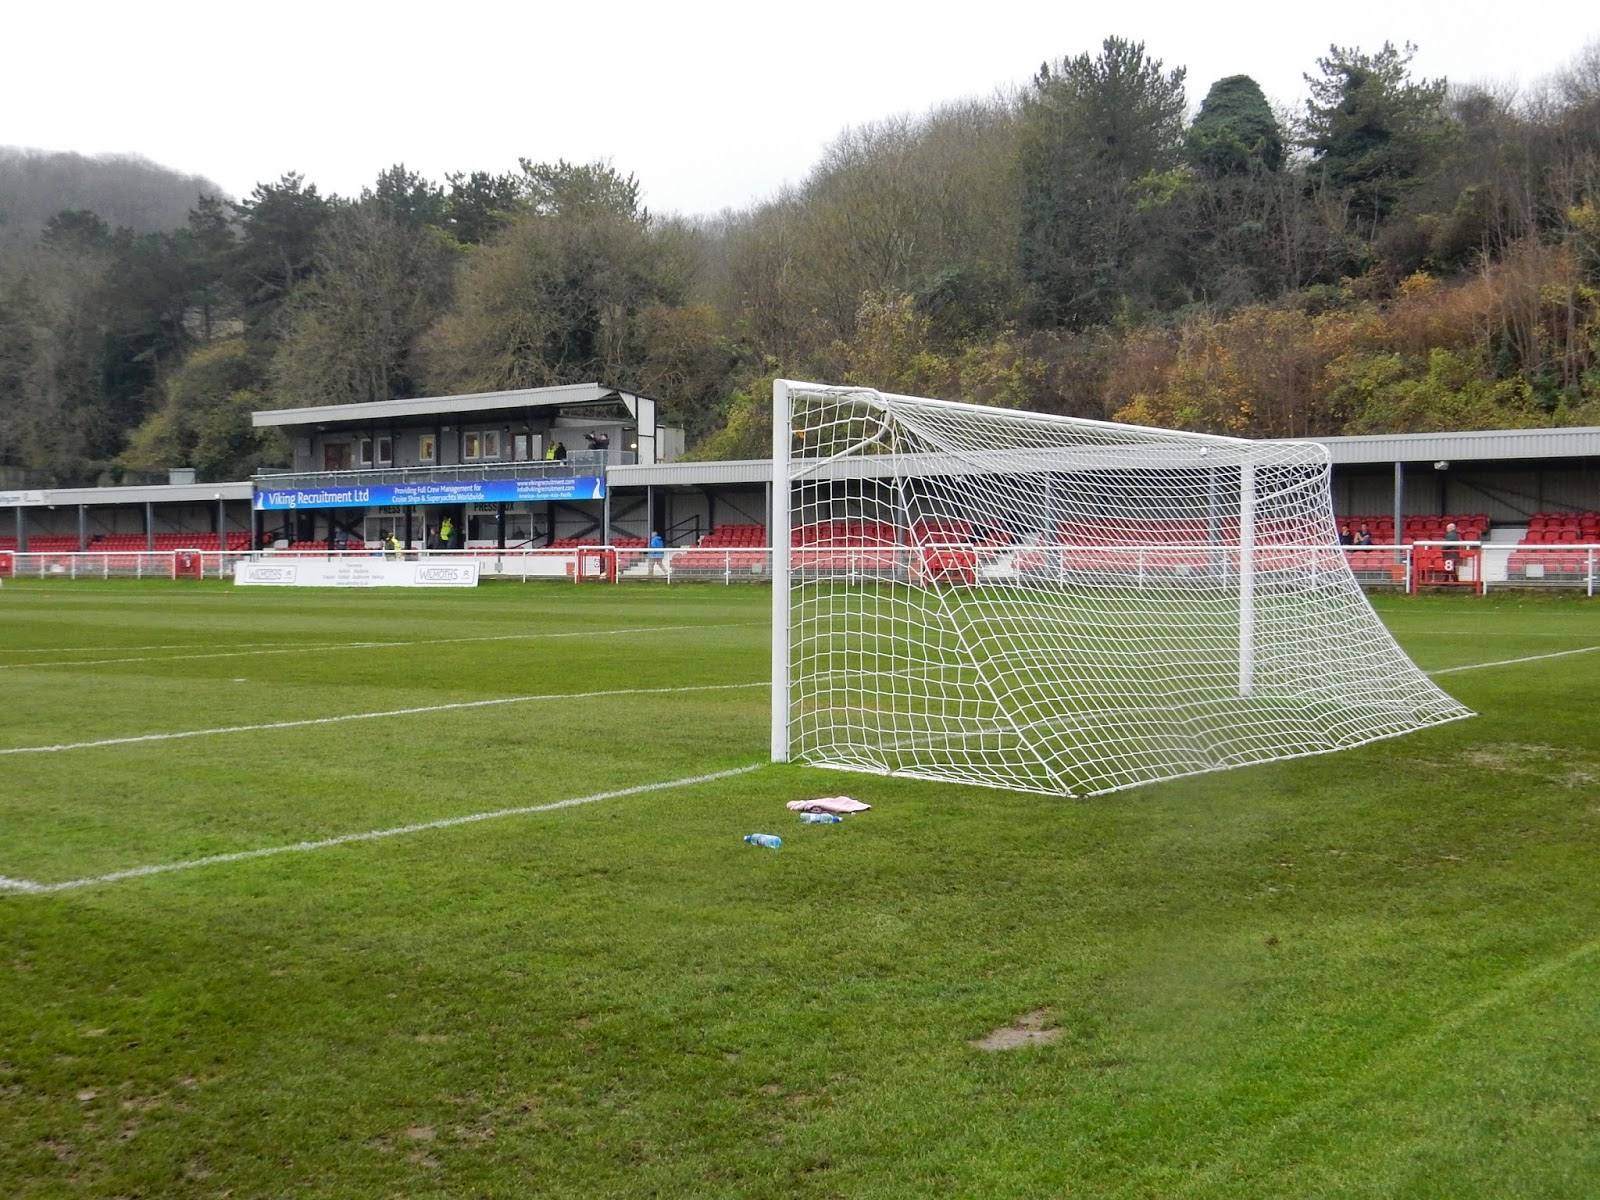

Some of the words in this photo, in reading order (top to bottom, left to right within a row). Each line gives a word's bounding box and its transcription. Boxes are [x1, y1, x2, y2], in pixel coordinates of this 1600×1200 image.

[516, 479, 575, 487] www.vikingrecruitment.com
[394, 486, 417, 495] Providing
[427, 485, 440, 493] Crew
[441, 484, 473, 494] Management
[474, 483, 482, 491] for
[268, 492, 296, 508] Viking
[298, 490, 352, 504] Recruitment
[354, 488, 369, 502] Ltd
[392, 495, 407, 503] Cruise
[408, 494, 420, 503] Ships
[427, 493, 457, 503] Superyachts
[457, 492, 485, 501] Worldwide
[379, 504, 401, 513] PRESS
[474, 502, 497, 511] PRESS
[948, 559, 953, 568] 7
[1444, 559, 1453, 571] 8
[420, 568, 459, 580] WILMOTHS
